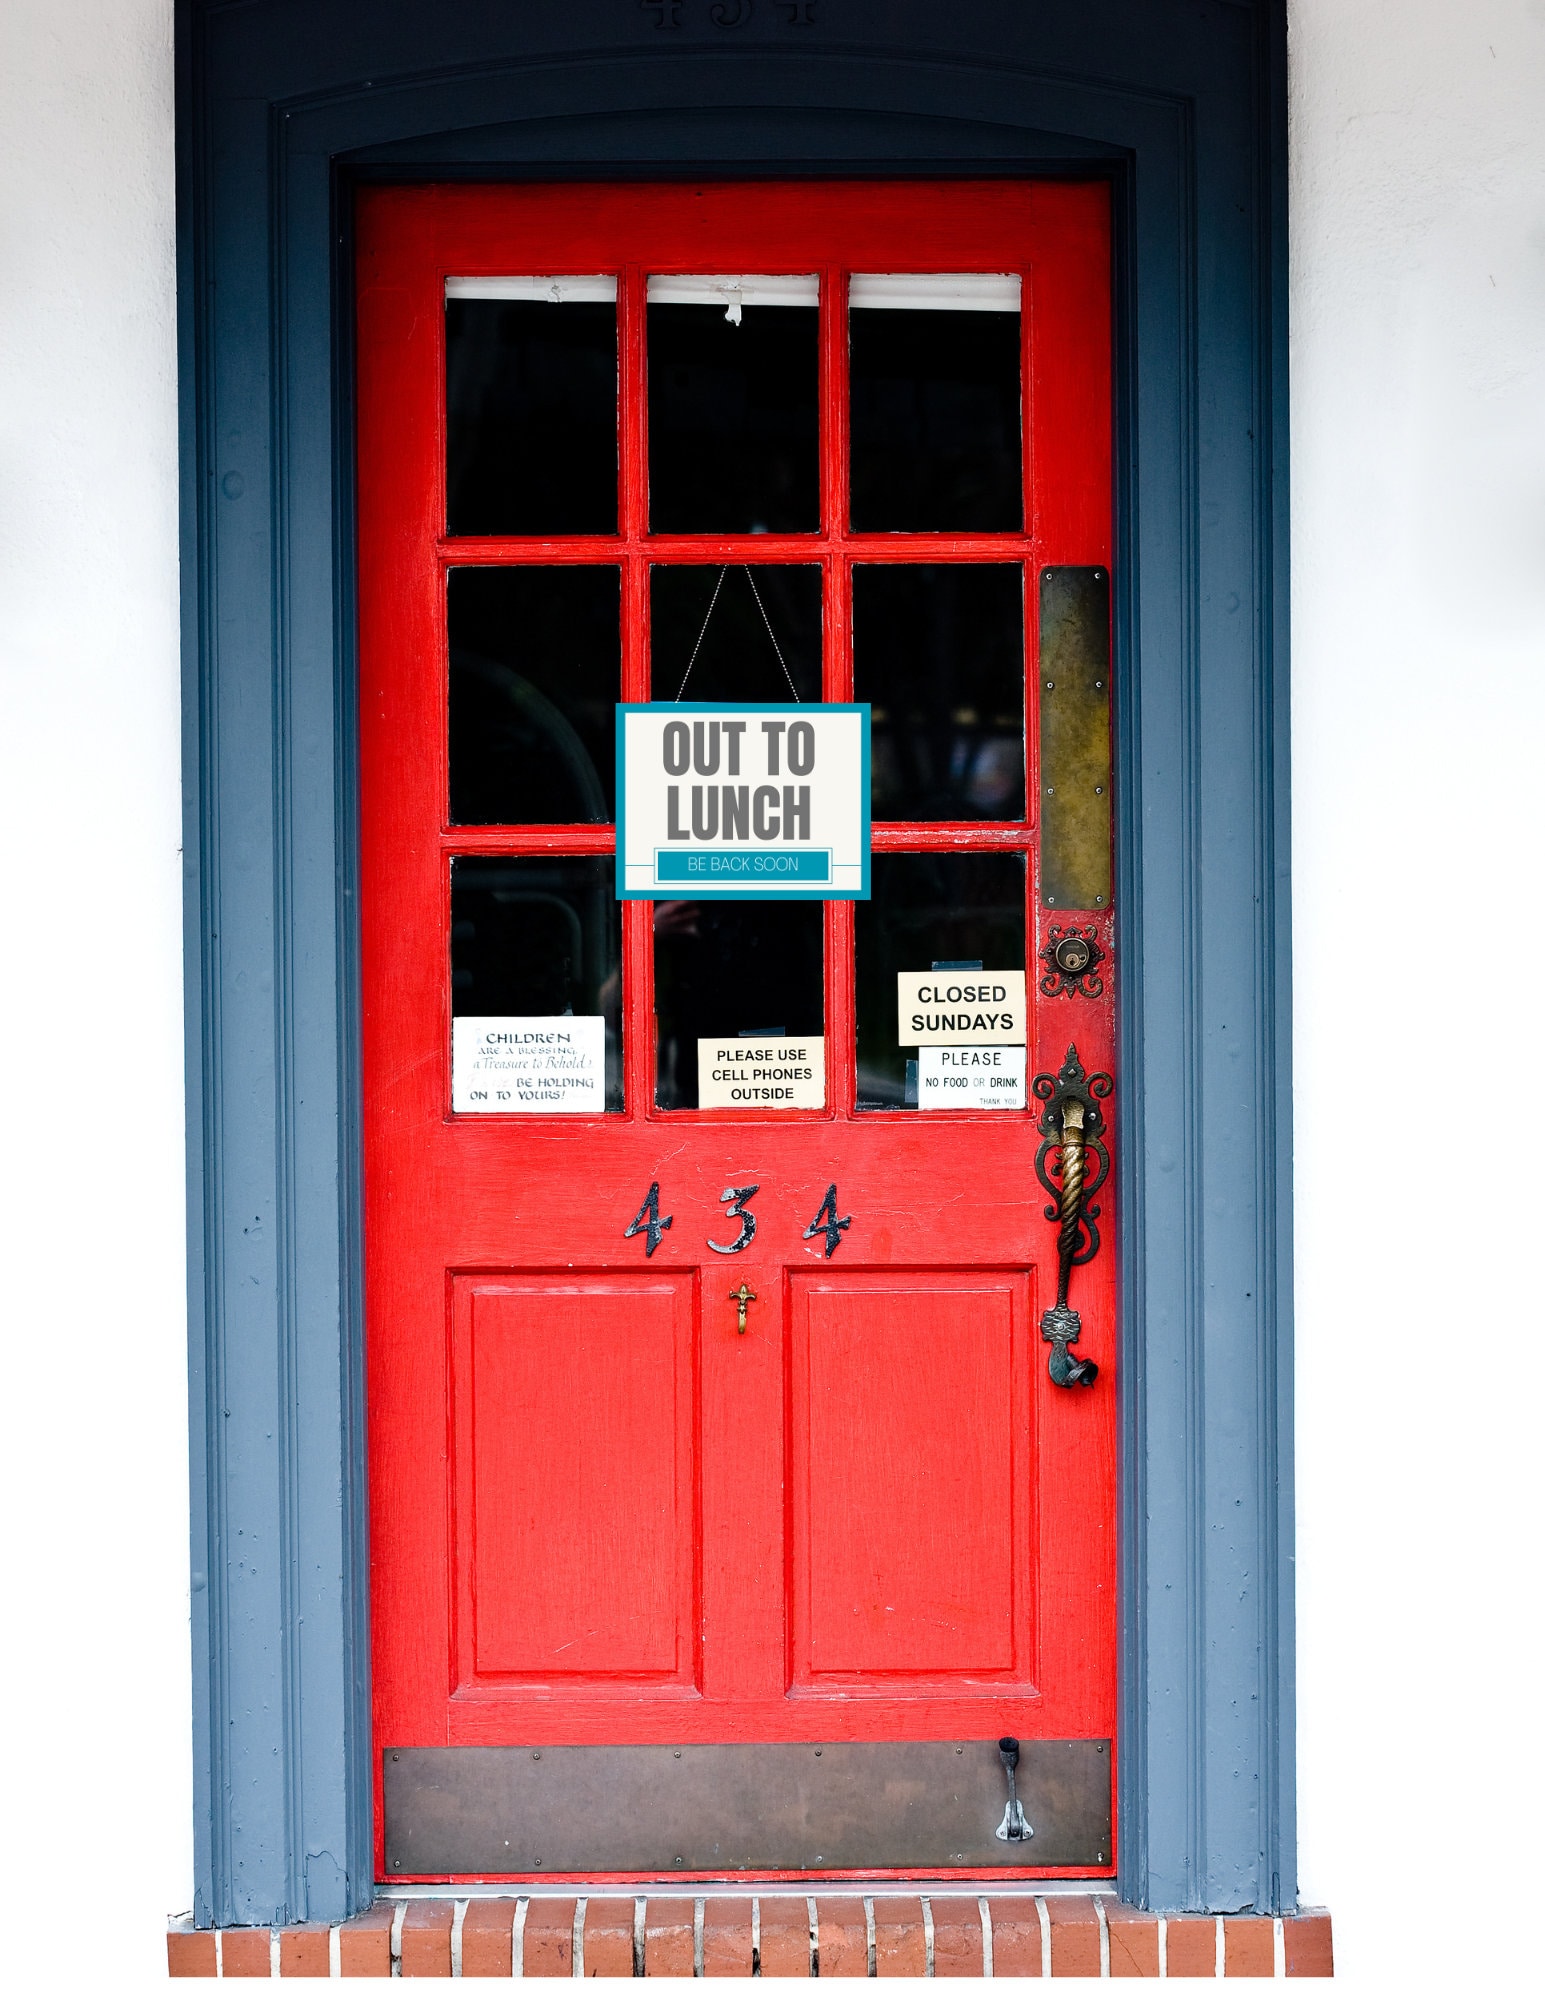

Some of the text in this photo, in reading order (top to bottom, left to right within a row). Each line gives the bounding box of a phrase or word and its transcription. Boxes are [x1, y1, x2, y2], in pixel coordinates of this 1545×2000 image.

[662, 720, 815, 777] OUT TO
[667, 785, 811, 841] LUNCH
[687, 856, 799, 872] BE BACK SOON
[917, 985, 1007, 1004] CLOSED
[911, 1013, 1014, 1032] SUNDAYS
[485, 1032, 571, 1045] CHILDREN
[477, 1046, 501, 1055] ARE
[505, 1047, 515, 1055] A
[716, 1048, 808, 1062] PLEASE USE
[472, 1060, 481, 1070] a
[481, 1056, 529, 1070] Treasure
[532, 1057, 543, 1070] to
[941, 1052, 1002, 1066] PLEASE
[711, 1067, 813, 1081] CELL PHONES
[516, 1077, 534, 1088] BE
[537, 1077, 595, 1090] HOLDING
[925, 1077, 1018, 1088] NO FOOD OR DRINK
[469, 1089, 566, 1101] ON TO YOURS!
[730, 1087, 795, 1100] OUTSIDE
[979, 1097, 1018, 1106] THANK YOU
